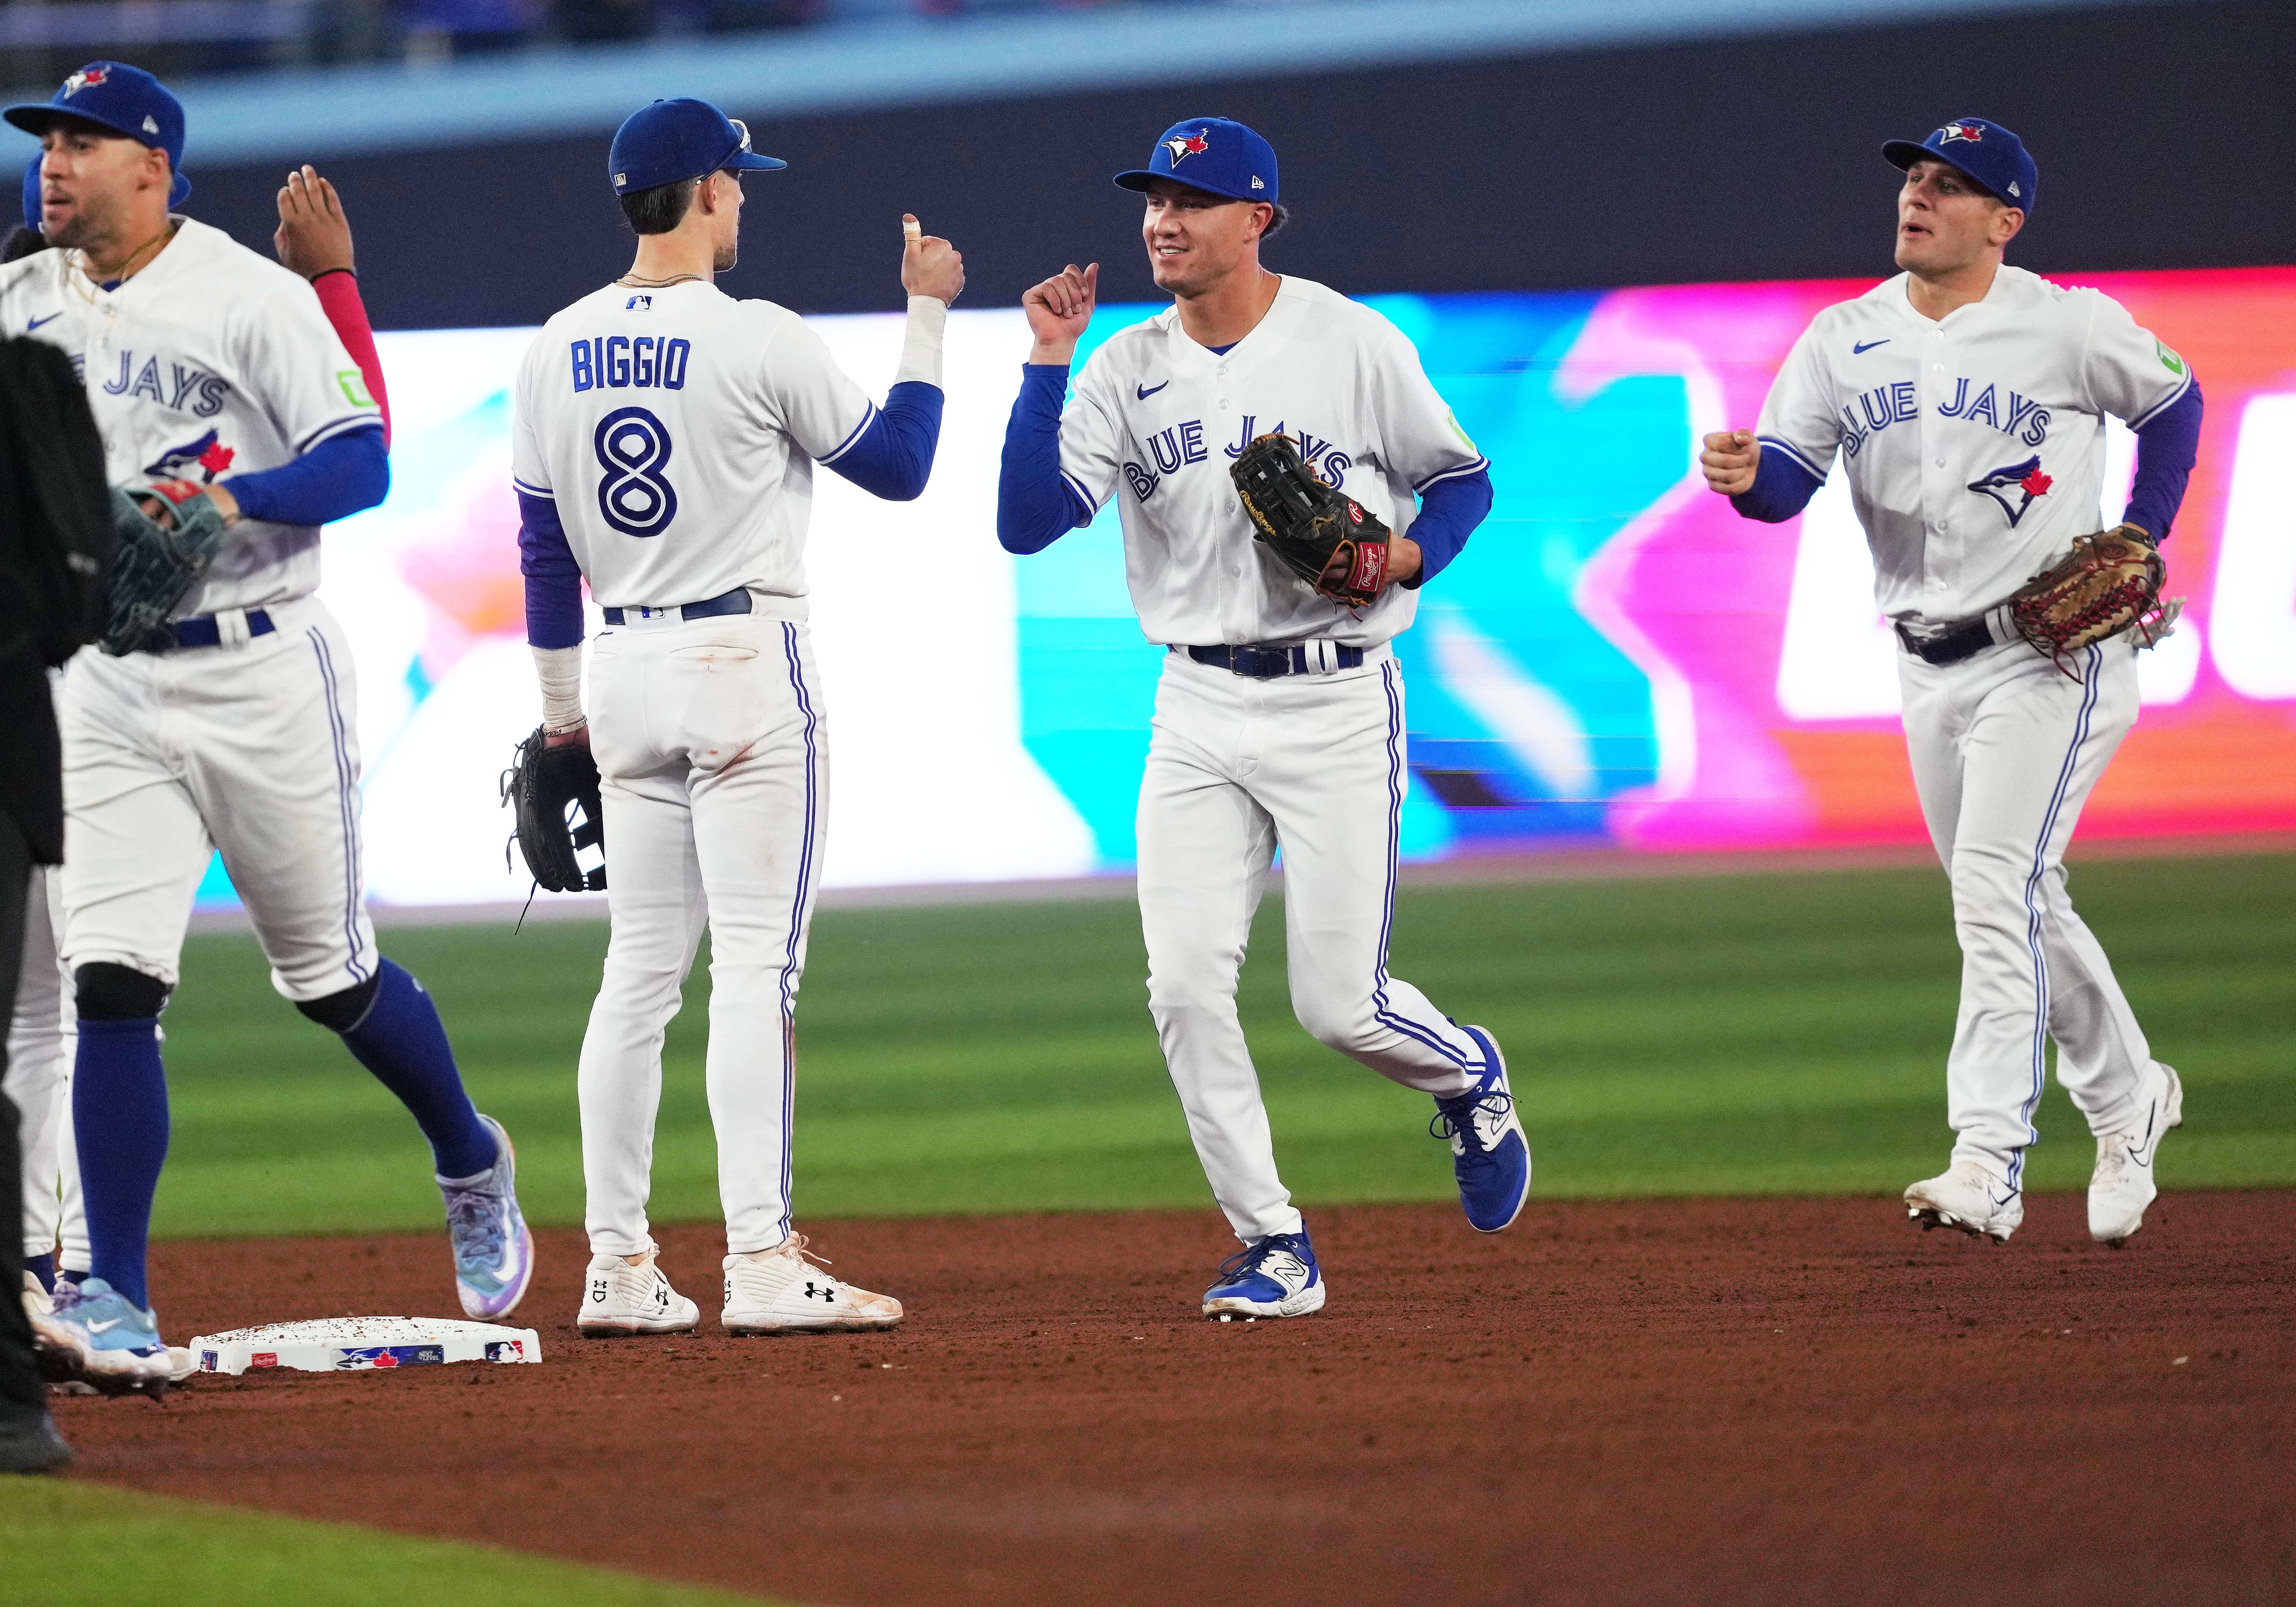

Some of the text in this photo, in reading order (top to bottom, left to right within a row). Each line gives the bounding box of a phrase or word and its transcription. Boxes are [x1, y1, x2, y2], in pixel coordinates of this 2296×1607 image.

[103, 350, 230, 418] JAYS
[571, 336, 690, 393] BIGGIO
[1937, 377, 2051, 447] JAYS
[594, 406, 678, 537] 8
[1123, 419, 1208, 503] BUE
[1240, 490, 1277, 535] Rawlings
[1362, 547, 1377, 586] Rawlings
